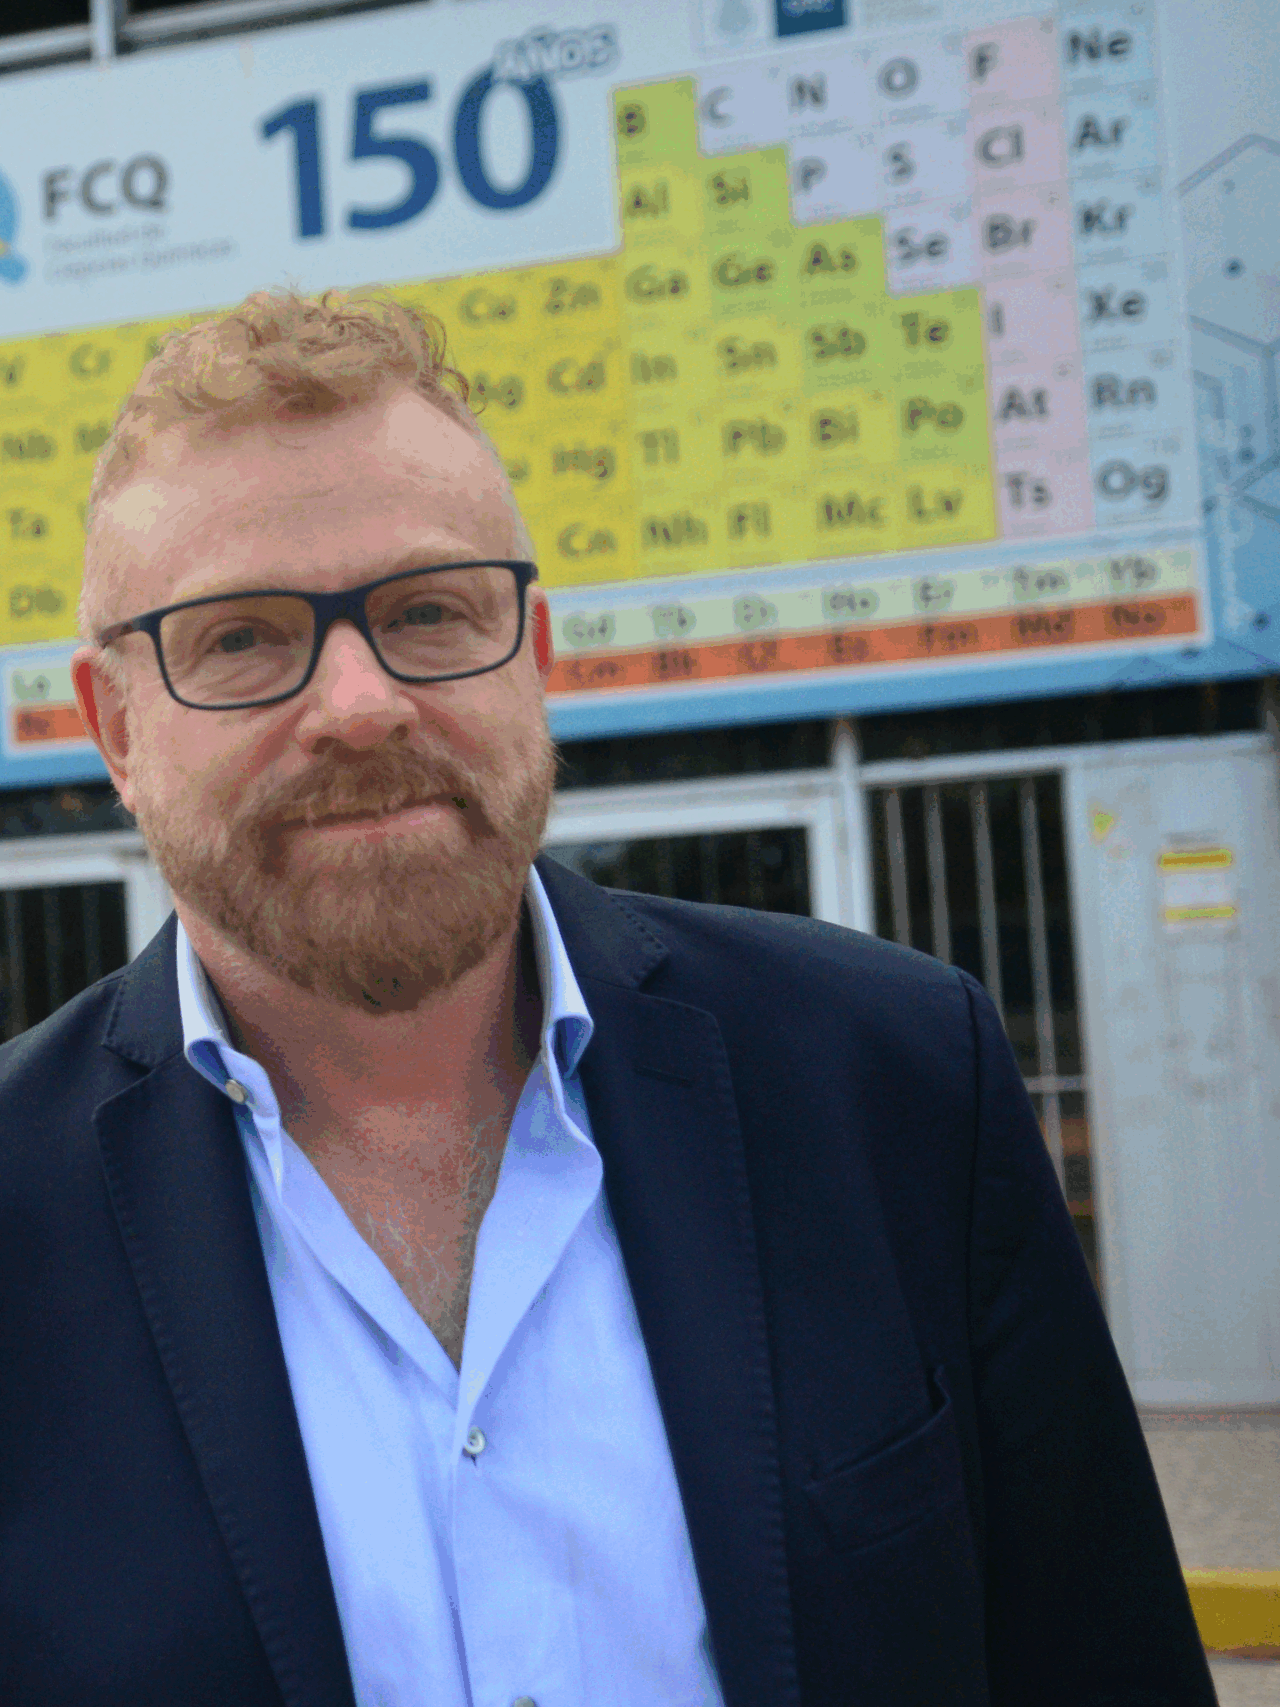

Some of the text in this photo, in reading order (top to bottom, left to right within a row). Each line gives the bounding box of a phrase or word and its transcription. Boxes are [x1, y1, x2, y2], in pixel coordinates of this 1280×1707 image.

[702, 86, 732, 128] C
[788, 72, 827, 114] N
[877, 56, 920, 101] O
[970, 42, 999, 84] F
[1068, 28, 1133, 64] Ne
[42, 152, 170, 220] FCQ
[258, 64, 562, 240] 150
[793, 156, 827, 192] P
[884, 142, 914, 185] S
[975, 124, 1024, 168] Cl
[1075, 114, 1130, 150] Ar
[712, 252, 776, 287] Ge
[805, 242, 858, 276] As
[892, 225, 950, 267] Se
[983, 213, 1037, 255] Br
[1079, 202, 1133, 236] Kr
[900, 312, 950, 347] Te
[1089, 288, 1147, 323] Xe
[901, 396, 964, 435] Po
[998, 387, 1048, 421] At
[1091, 373, 1156, 407] Rn
[1095, 458, 1169, 509] Og
